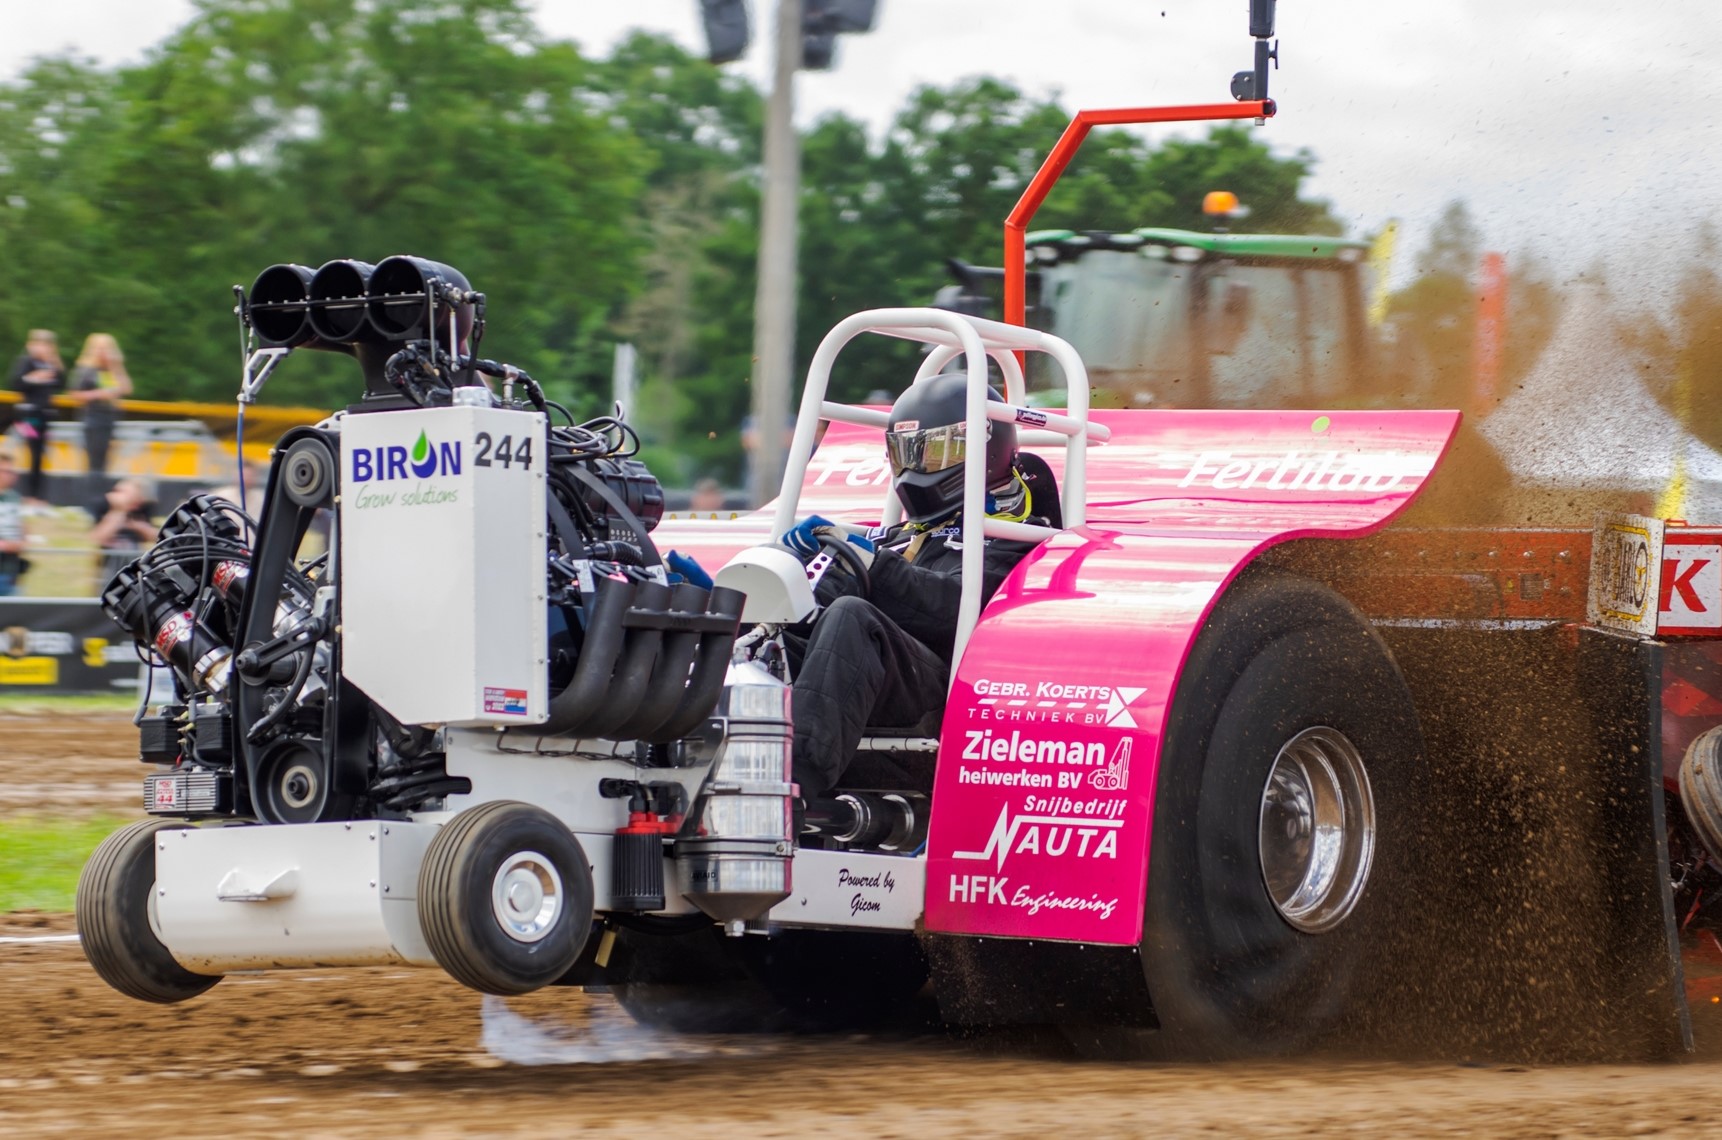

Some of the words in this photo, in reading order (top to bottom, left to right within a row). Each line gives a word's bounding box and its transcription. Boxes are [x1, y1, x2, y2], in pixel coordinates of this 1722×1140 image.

[352, 437, 462, 483] BIRON
[474, 432, 532, 471] 244
[1177, 450, 1403, 493] Fertilab
[355, 484, 397, 509] Grow
[400, 482, 459, 506] solutions
[973, 679, 1030, 697] GEBR.
[1036, 682, 1110, 700] KOERTS
[968, 708, 1075, 723] TECHNIEK
[1085, 713, 1106, 724] BV
[962, 730, 1106, 766] Zieleman
[959, 766, 1052, 788] heiwerken
[1057, 771, 1083, 789] BV
[1024, 795, 1128, 820] Snijbedrijf
[986, 800, 1117, 874] NAUTA
[838, 868, 881, 888] Powered
[883, 871, 895, 893] by
[850, 893, 881, 916] Gicom
[949, 874, 1008, 905] HFK
[1011, 885, 1118, 920] Engineering
